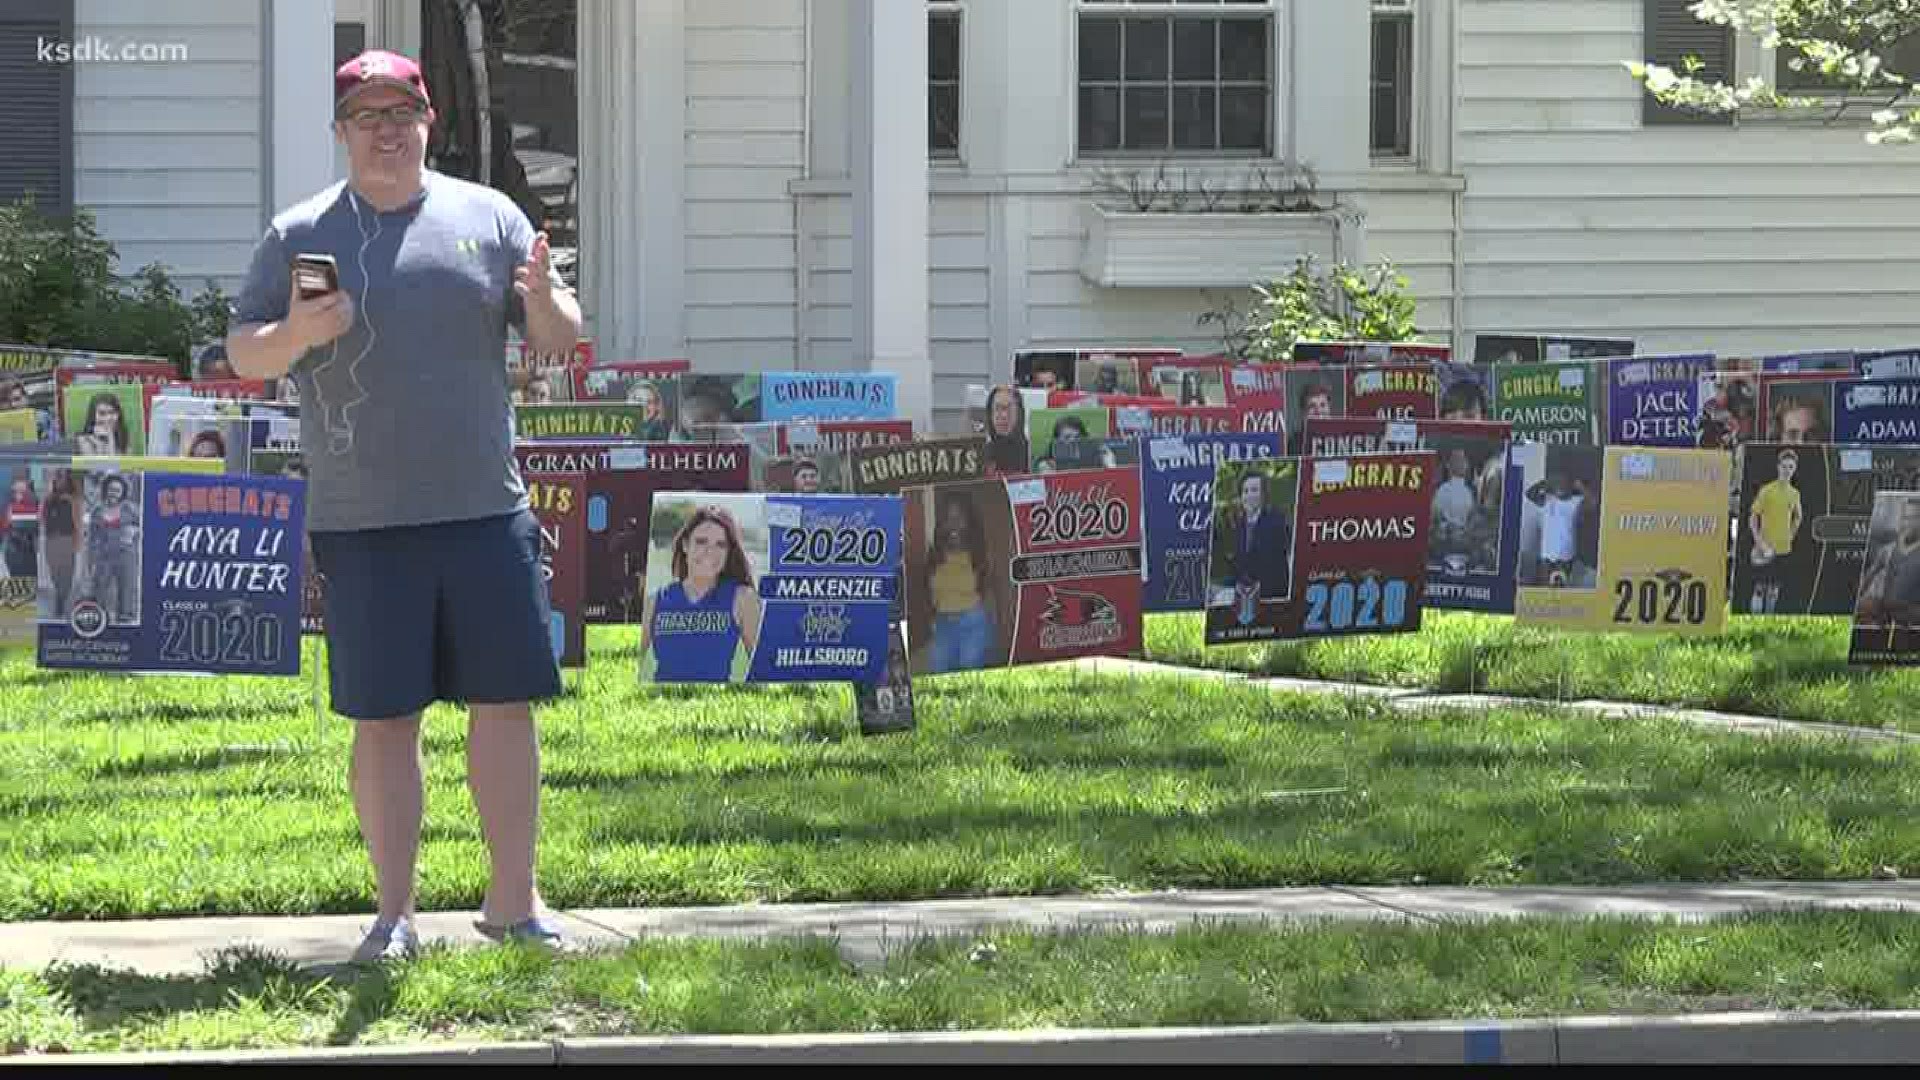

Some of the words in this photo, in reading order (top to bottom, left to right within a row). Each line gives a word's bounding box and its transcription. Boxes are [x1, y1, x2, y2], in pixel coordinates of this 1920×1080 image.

[773, 378, 884, 404] CONGRATS
[1634, 391, 1690, 419] JACK
[1501, 406, 1587, 424] CAMERON
[1856, 419, 1918, 440] ADAM
[861, 445, 978, 485] CONGRATS
[157, 487, 291, 521] CONGRATS
[1029, 498, 1129, 545] 2020
[1307, 516, 1416, 543] THOMAS
[169, 524, 240, 554] AIYA
[255, 527, 284, 557] LI
[779, 527, 888, 568] 2020
[160, 560, 291, 594] HUNTER
[776, 577, 883, 598] MAKENZIE
[1303, 579, 1408, 629] 2020
[1613, 577, 1708, 625] 2020
[160, 612, 282, 665] 2020
[774, 647, 869, 667] HILLSBORO
